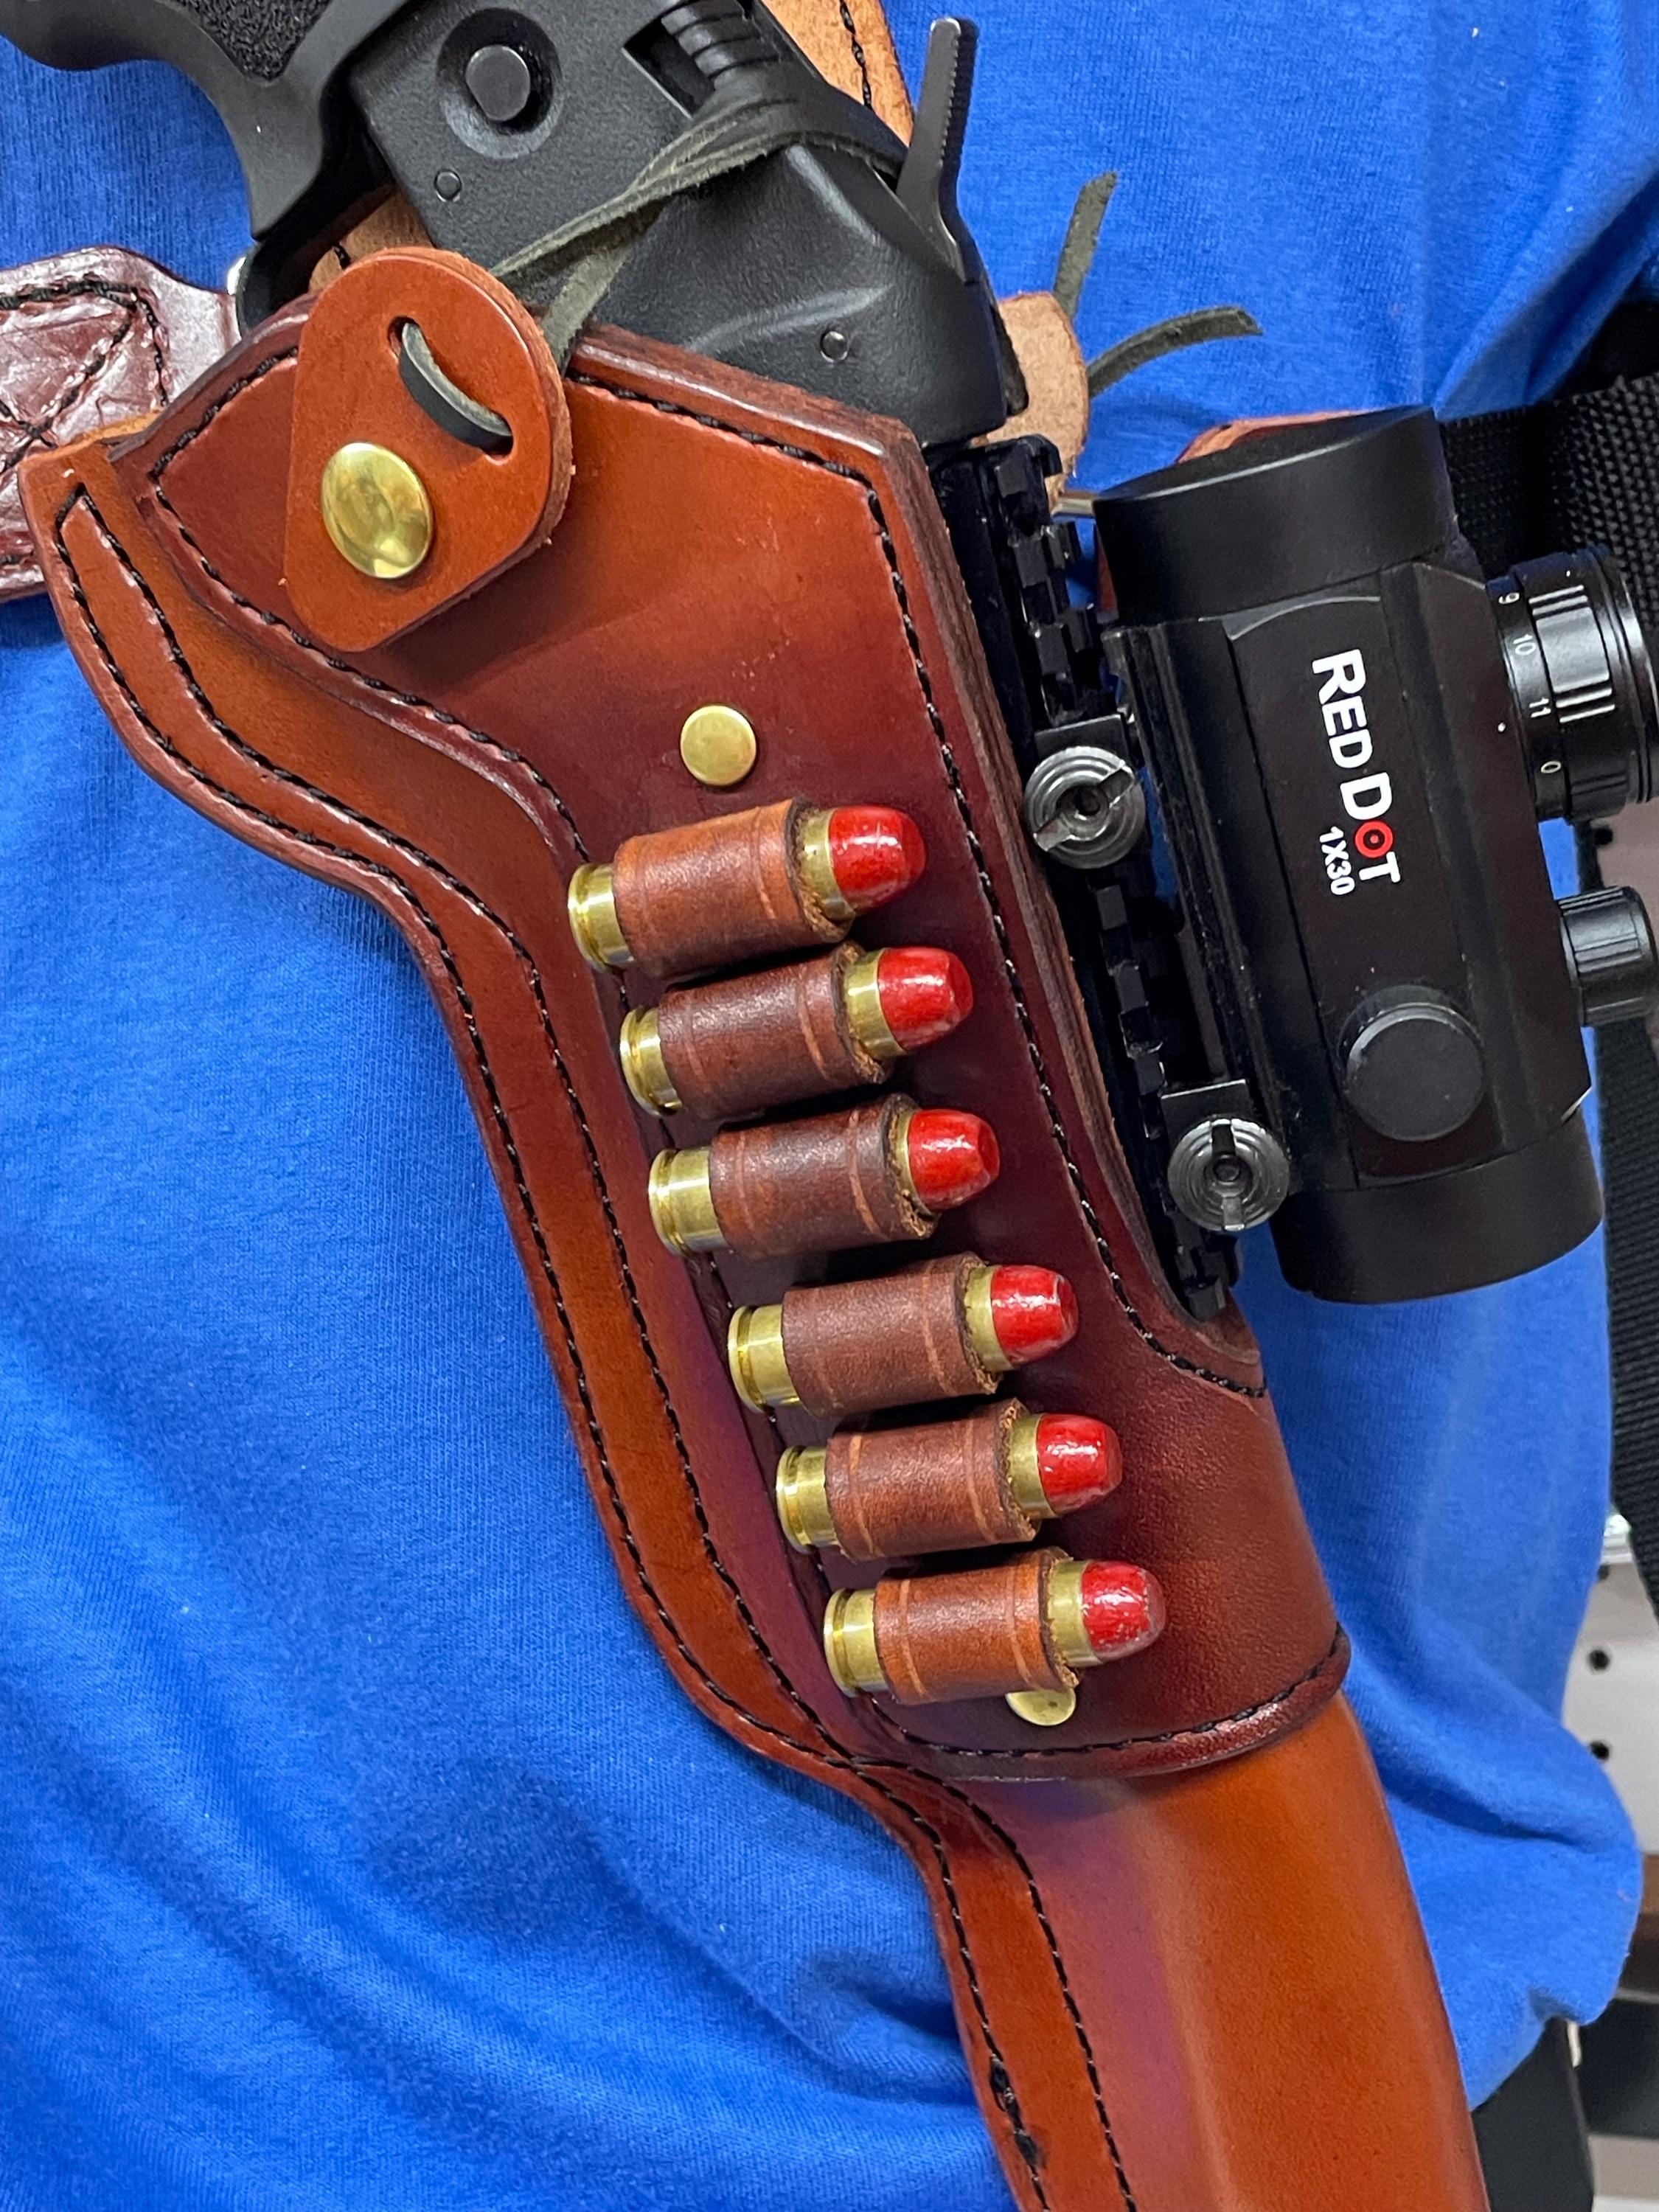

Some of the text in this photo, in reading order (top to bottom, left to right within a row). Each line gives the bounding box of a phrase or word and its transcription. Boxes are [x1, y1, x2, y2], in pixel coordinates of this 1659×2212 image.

[1513, 633, 1537, 655] 10
[1528, 698, 1551, 718] 11
[1312, 649, 1401, 883] RED DOT
[1540, 760, 1562, 774] 0
[1319, 826, 1355, 896] 1X30
